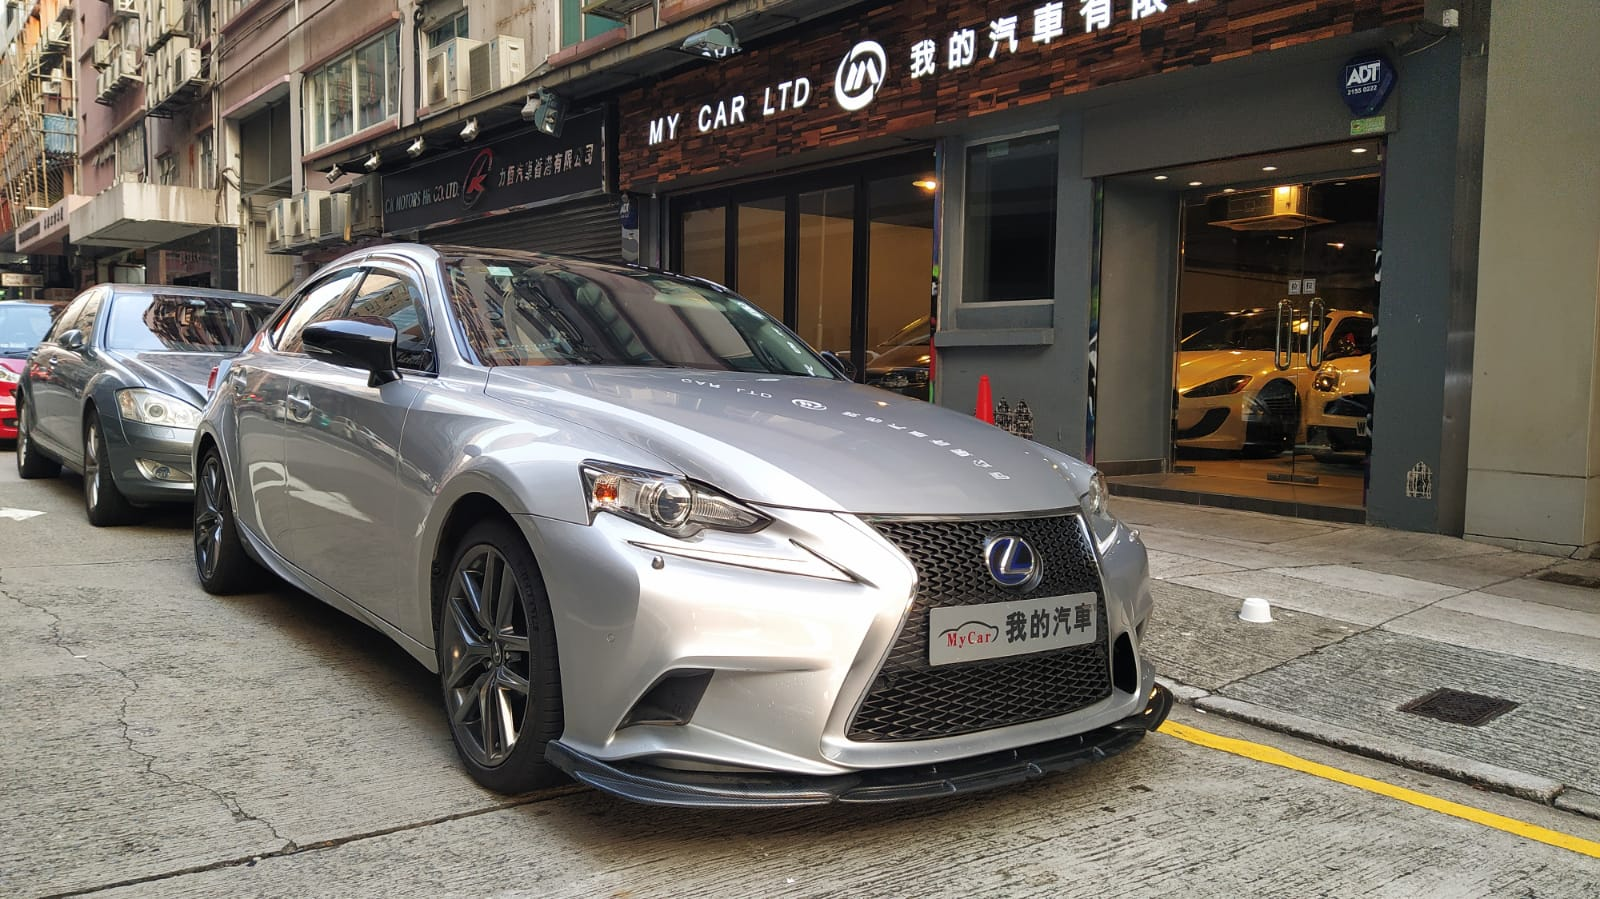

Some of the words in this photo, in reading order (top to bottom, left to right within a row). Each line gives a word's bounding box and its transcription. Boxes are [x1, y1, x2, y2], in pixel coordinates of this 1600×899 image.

[1347, 63, 1380, 86] ADT
[649, 112, 680, 146] MY
[698, 96, 745, 133] CAR
[762, 77, 810, 116] LTD
[395, 190, 421, 212] MOTORS
[946, 630, 992, 649] MyCar
[1005, 601, 1093, 644] 我的汽車
